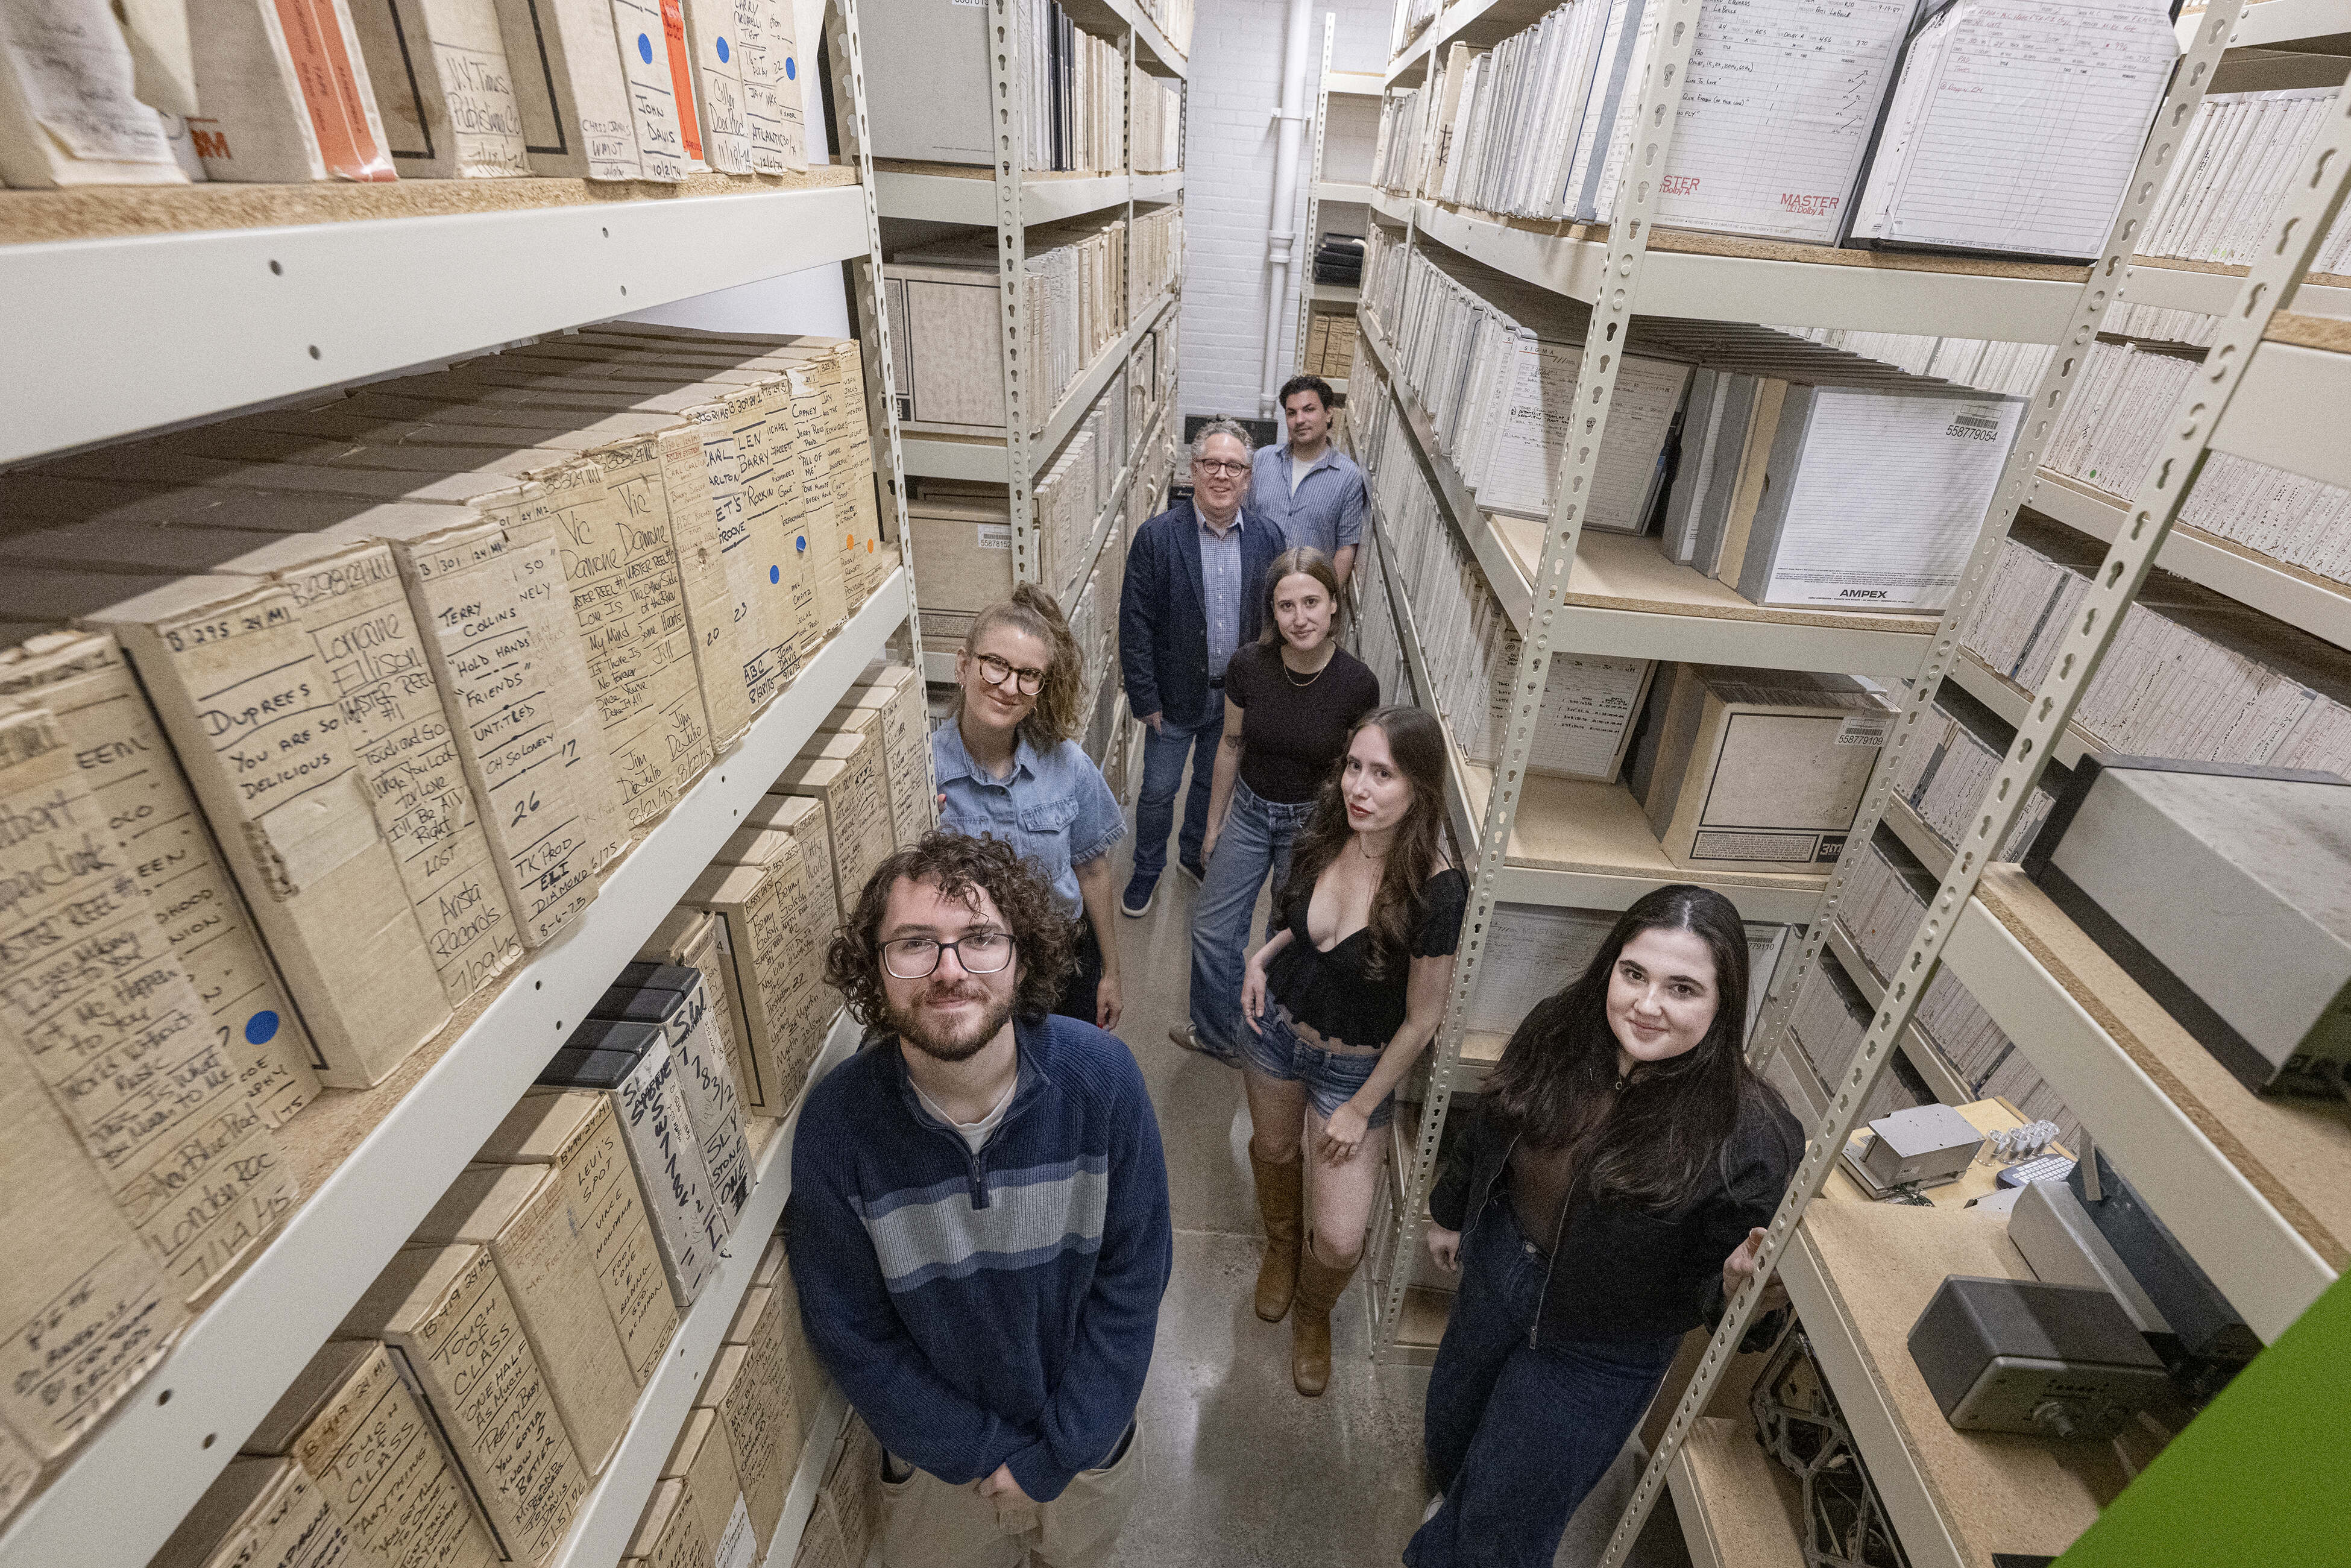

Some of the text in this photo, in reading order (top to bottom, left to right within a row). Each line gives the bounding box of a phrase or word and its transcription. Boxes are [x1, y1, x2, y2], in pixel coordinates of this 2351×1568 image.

[635, 95, 664, 118] JOHN
[646, 120, 675, 143] DAVIS
[752, 123, 783, 146] ATLANTIC
[653, 160, 681, 178] 10/2/74
[1662, 175, 1700, 191] STER
[1663, 185, 1683, 197] Dolby
[1780, 193, 1839, 209] MASTER
[1797, 206, 1825, 216] Dolby A
[1525, 346, 1554, 354] SIGMA
[738, 430, 761, 450] LEN
[796, 424, 825, 438] JERRY ROSS
[1946, 425, 1998, 442] 558779054
[737, 449, 769, 473] BARRY
[814, 452, 822, 462] OF
[617, 484, 652, 518] Vic
[805, 495, 820, 505] EVERY
[557, 511, 594, 546] Vic
[615, 521, 669, 561] Damone
[981, 540, 1011, 548] 55878152
[559, 549, 625, 581] Damone
[1839, 589, 1887, 599] AMPEX
[438, 602, 482, 627] TERRY
[464, 608, 517, 637] COLLINS
[576, 611, 603, 628] Love
[661, 610, 682, 632] Hearts
[734, 602, 747, 623] 23
[589, 622, 630, 656] My Mind
[707, 627, 719, 646] 20
[603, 655, 630, 672] There
[653, 640, 674, 664] Jill
[777, 643, 793, 660] JOHN
[777, 651, 797, 670] DAVIS
[597, 676, 611, 690] No
[744, 660, 764, 682] ABC
[669, 704, 691, 728] Jim
[279, 729, 311, 752] ARE
[318, 719, 339, 732] SO
[1839, 735, 1883, 745] 558779109
[486, 732, 555, 774] OH SO LONELY
[561, 739, 576, 757] 17
[620, 748, 648, 770] Jim
[241, 753, 330, 799] DELICIOUS
[512, 790, 540, 828] 26
[515, 839, 573, 878] TK PROD
[541, 861, 570, 892] ELI
[439, 881, 482, 925] Arista
[531, 869, 590, 914] DIAMOND
[716, 940, 723, 951] 4
[713, 1136, 741, 1185] STONE
[583, 1157, 612, 1203] SPOT
[596, 1188, 622, 1229] VINCE
[612, 1238, 635, 1277] FOOT
[614, 1250, 636, 1286] CONE
[434, 1298, 496, 1365] TOUCH
[466, 1323, 489, 1357] OF
[455, 1323, 509, 1396] CLASS
[466, 1340, 526, 1422] ONE HALF
[476, 1409, 493, 1431] AS
[348, 1422, 415, 1504] CLASS
[500, 1450, 532, 1494] KNOW
[515, 1436, 556, 1496] BETTER
[524, 1490, 555, 1535] JOHN
[541, 1483, 568, 1526] DAVIS
